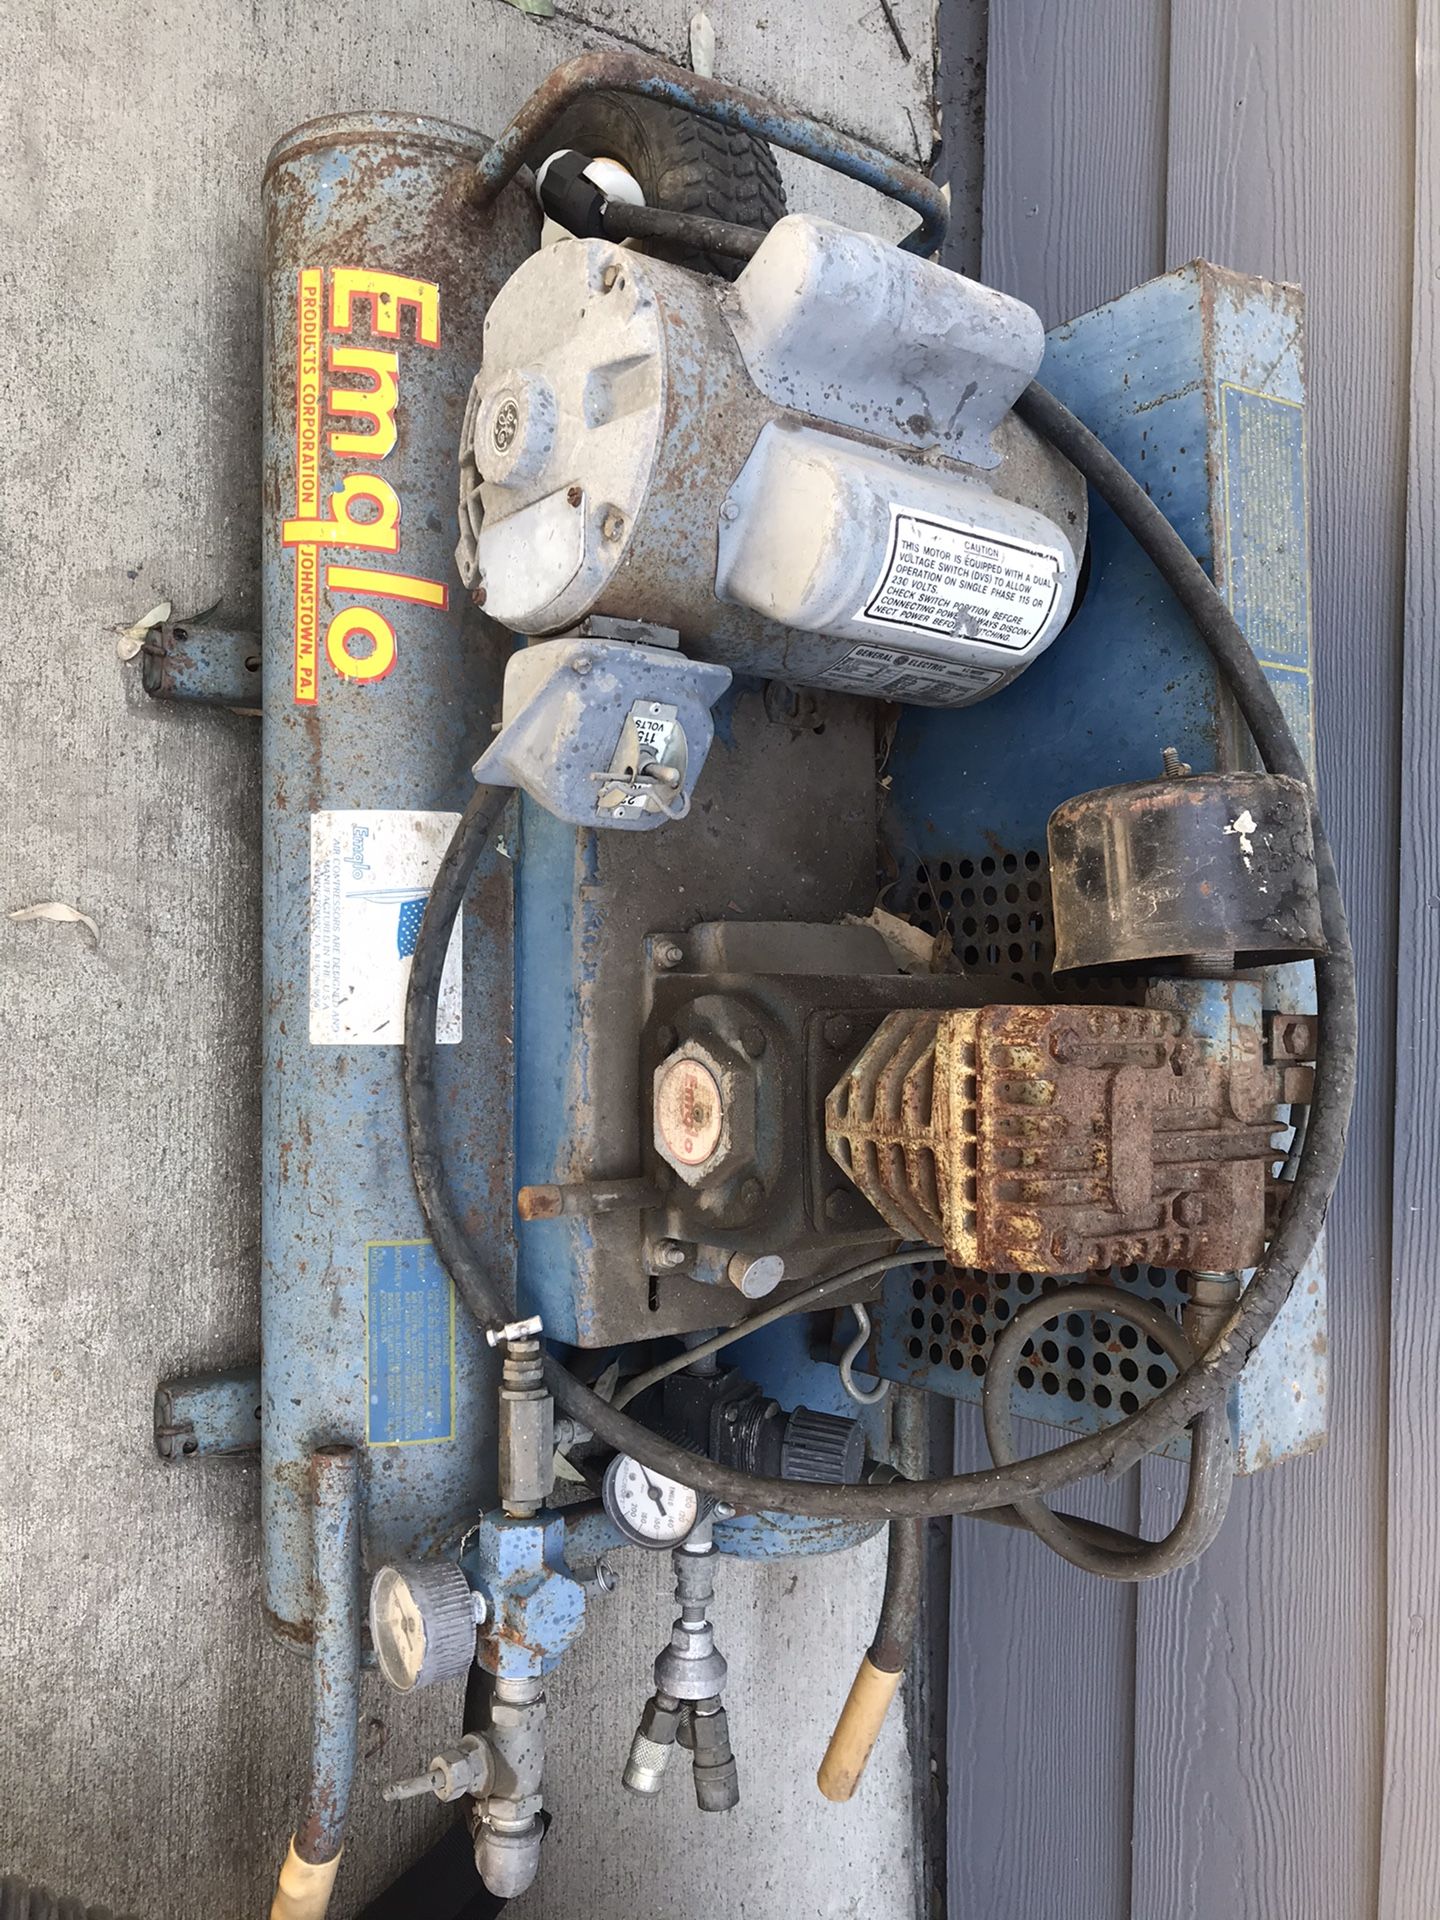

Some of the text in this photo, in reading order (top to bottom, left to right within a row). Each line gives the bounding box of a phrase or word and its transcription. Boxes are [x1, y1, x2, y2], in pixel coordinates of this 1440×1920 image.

[299, 286, 317, 694] PRODUCTS CORPORATION JOHNSTOWN, PA.
[902, 540, 920, 553] THIS
[923, 546, 951, 560] MOTOR
[954, 555, 962, 564] IS
[965, 558, 1002, 574] EQUIPPED
[1005, 568, 1023, 580] WITH
[1033, 575, 1051, 588] DUAL
[964, 541, 999, 558] CAUTION
[892, 575, 938, 594] 230 VOLTS.
[896, 564, 1043, 608] OPERATION ON SINGLE PHASE 115 OR
[900, 552, 1032, 594] VOLTAGE SWITCH (DVS) TO ALLOW
[874, 605, 899, 615] NECT
[900, 611, 930, 622] POWER
[881, 596, 935, 614] CONNECTING
[999, 624, 1031, 635] DISCON-
[887, 586, 916, 599] CHECK
[918, 594, 951, 608] SWITCH
[992, 612, 1024, 626] BEFORE
[855, 648, 893, 662] GENERAL
[908, 659, 947, 672] ELECTRIC
[635, 719, 664, 732] VOLTS
[333, 838, 341, 855] AIR
[333, 858, 341, 932] COMPRESSORS
[630, 1503, 638, 1518] 200
